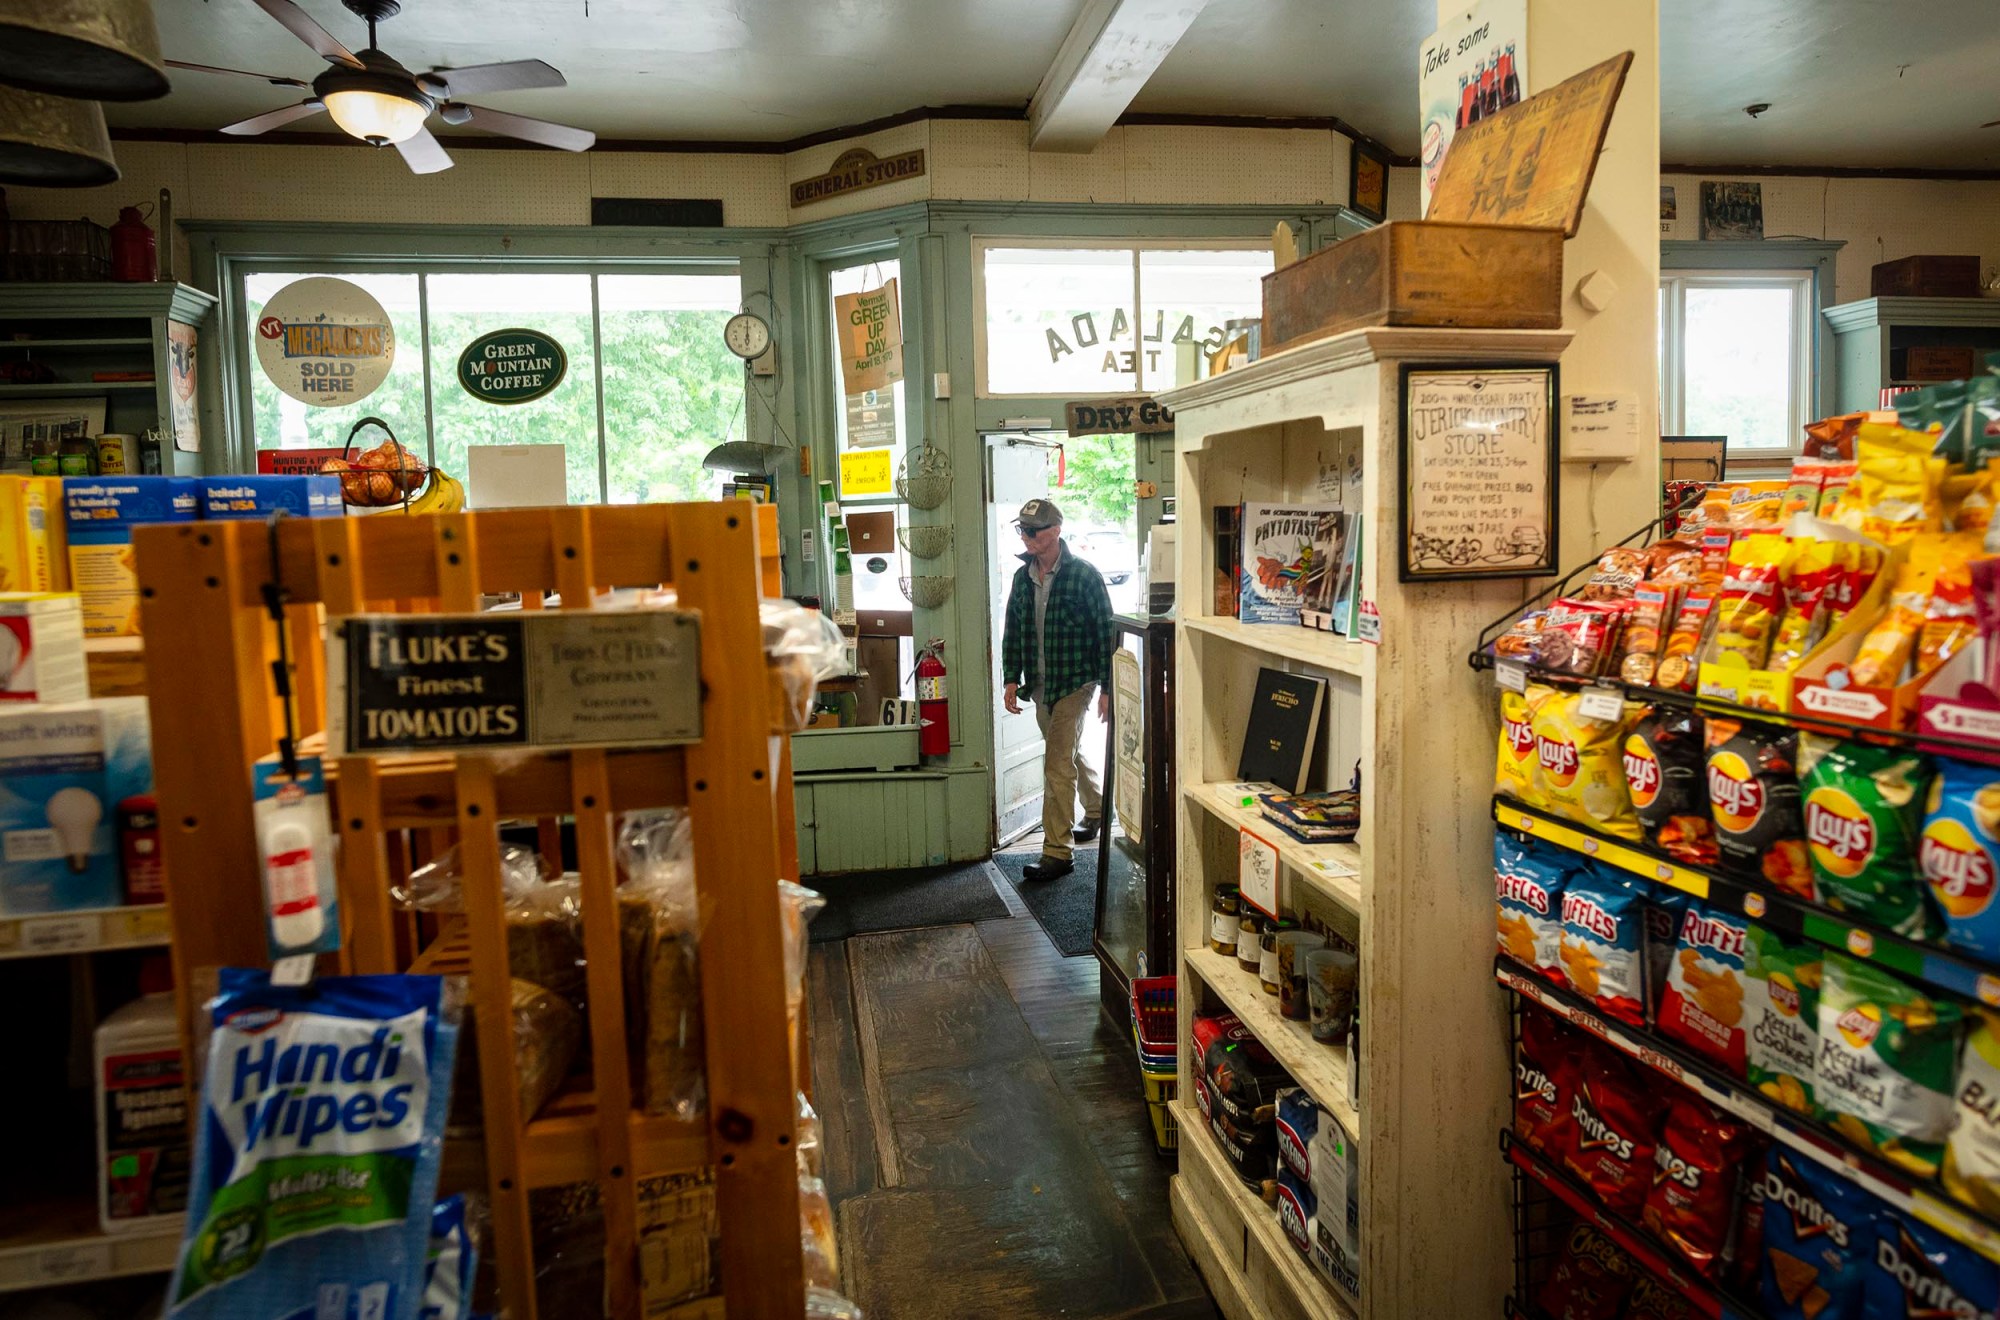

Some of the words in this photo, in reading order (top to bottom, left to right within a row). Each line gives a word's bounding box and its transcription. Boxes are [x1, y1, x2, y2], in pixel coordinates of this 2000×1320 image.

[1424, 46, 1450, 79] Take
[1457, 21, 1490, 56] some
[795, 170, 862, 202] GENERAL
[866, 155, 919, 184] STORE
[857, 292, 886, 307] Vermont
[850, 301, 890, 326] GREEN
[261, 319, 280, 336] VT
[868, 321, 884, 340] UP
[287, 326, 382, 356] MEGABUCKS
[484, 343, 536, 359] GREEN
[865, 336, 887, 358] DAY
[300, 362, 355, 377] SOLD
[856, 357, 873, 371] April
[302, 378, 354, 393] HERE
[480, 374, 545, 391] COFFEE
[1509, 392, 1539, 406] PARTY
[1076, 406, 1134, 430] DRY
[1414, 407, 1475, 440] JERICHO
[1480, 407, 1541, 443] COUNTRY
[1444, 433, 1504, 456] STORE
[273, 457, 307, 465] HUNTING
[208, 487, 243, 498] baked
[244, 488, 256, 498] in
[210, 501, 229, 511] the
[230, 500, 256, 511] USA
[1511, 507, 1522, 519] BY
[1255, 519, 1319, 546] PHYTOTAST
[368, 630, 509, 669] FLUKE'S
[398, 675, 483, 697] Finest
[364, 705, 518, 741] TOMATOES
[1538, 735, 1576, 774] Lay's
[1623, 755, 1657, 791] ay's
[1709, 766, 1759, 815] Lay's
[1809, 803, 1870, 858] Lay's
[1922, 837, 1990, 897] Lay's
[1563, 895, 1616, 941] UFFLES
[1510, 974, 1542, 999] RUFFLES
[1569, 1009, 1607, 1035] RUFFLES
[1681, 1003, 1732, 1041] CHEDDAR
[1762, 1007, 1808, 1046] Kettle
[1753, 1025, 1815, 1069] Cooked
[1518, 1063, 1557, 1104] oritos
[1571, 1094, 1635, 1160] Doritos
[1765, 1172, 1849, 1248] Doritos
[1316, 1245, 1331, 1269] THE
